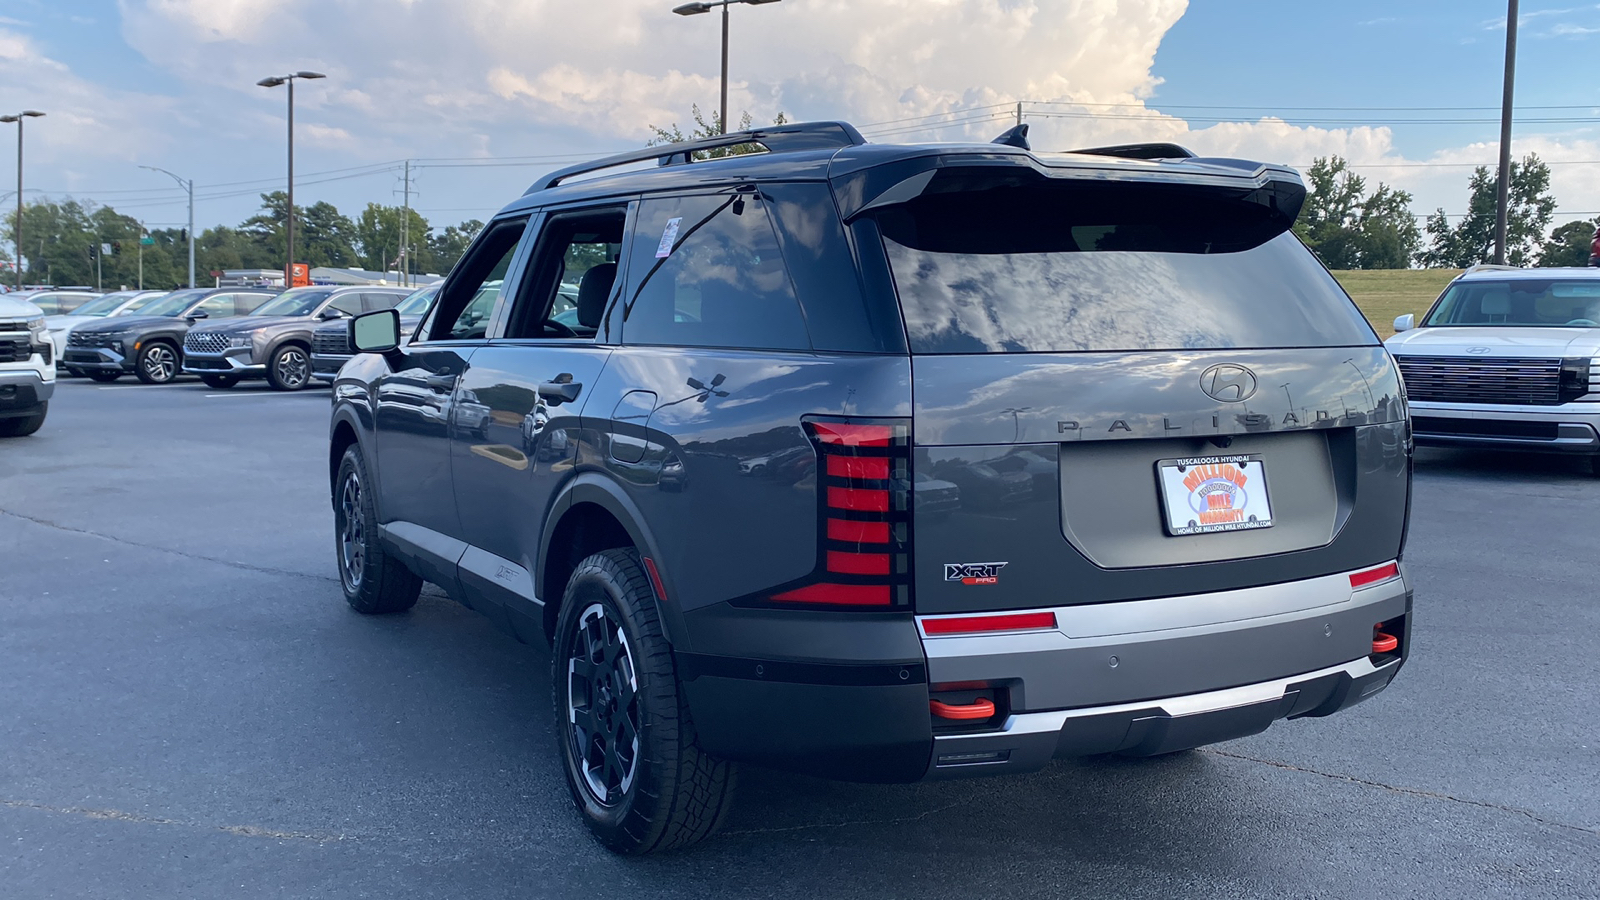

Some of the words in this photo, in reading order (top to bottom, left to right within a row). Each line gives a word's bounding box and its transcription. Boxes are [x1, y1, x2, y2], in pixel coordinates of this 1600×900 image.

[1057, 407, 1358, 434] PALISADE
[1176, 457, 1220, 466] TUSCALOOSA
[1221, 455, 1250, 463] HYUNDAI
[1183, 463, 1248, 493] MILLION
[1206, 493, 1233, 510] MILE
[1198, 508, 1244, 524] WARRANTY
[1203, 524, 1225, 533] MILLION
